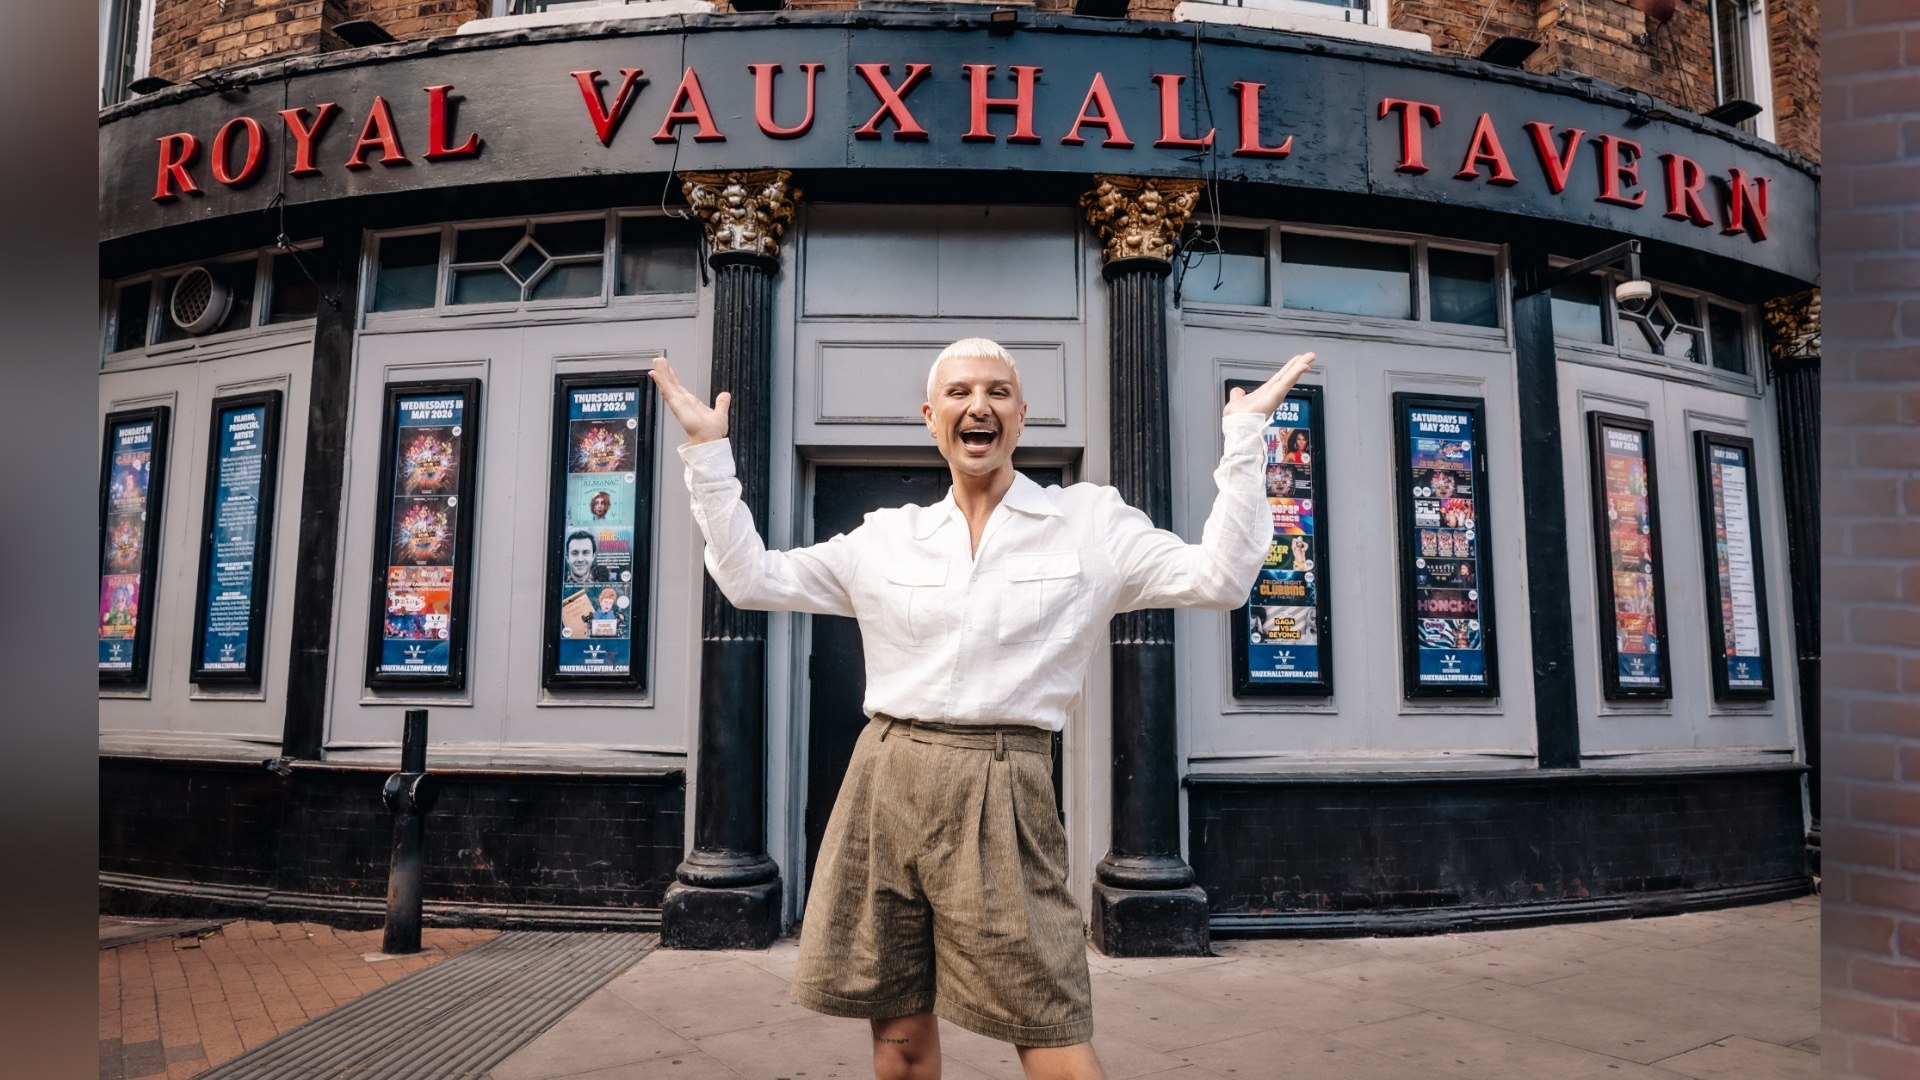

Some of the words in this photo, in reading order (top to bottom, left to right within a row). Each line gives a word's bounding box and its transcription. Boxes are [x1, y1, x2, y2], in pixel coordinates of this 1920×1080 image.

[151, 84, 478, 201] ROYAL
[570, 64, 1292, 158] VAUXHALL
[1379, 97, 1771, 241] TAVERN
[574, 392, 623, 403] THURSDAYS
[625, 392, 635, 401] IN
[401, 400, 454, 410] WEDNESDAYS
[455, 400, 464, 409] IN
[582, 403, 601, 412] MAY
[603, 402, 626, 411] 2026
[1290, 403, 1299, 412] IN
[411, 410, 430, 419] MAY
[431, 409, 453, 418] 2026
[1276, 411, 1299, 421] 2026
[1412, 413, 1457, 424] SATURDAYS
[1458, 416, 1467, 424] IN
[119, 427, 144, 437] MONDAYS
[1420, 423, 1437, 431] MAY
[1439, 424, 1461, 433] 2026
[121, 436, 134, 445] MAY
[234, 431, 254, 440] ARTISTS
[1608, 431, 1632, 442] SUNDAYS
[1610, 440, 1623, 449] MAY
[1624, 441, 1638, 451] 2026
[583, 479, 619, 487] ALMANAC
[1260, 584, 1305, 596] CLUBBING
[1417, 599, 1478, 612] HONCHO
[1250, 670, 1319, 678] VAUXHALLTAVERN.COM
